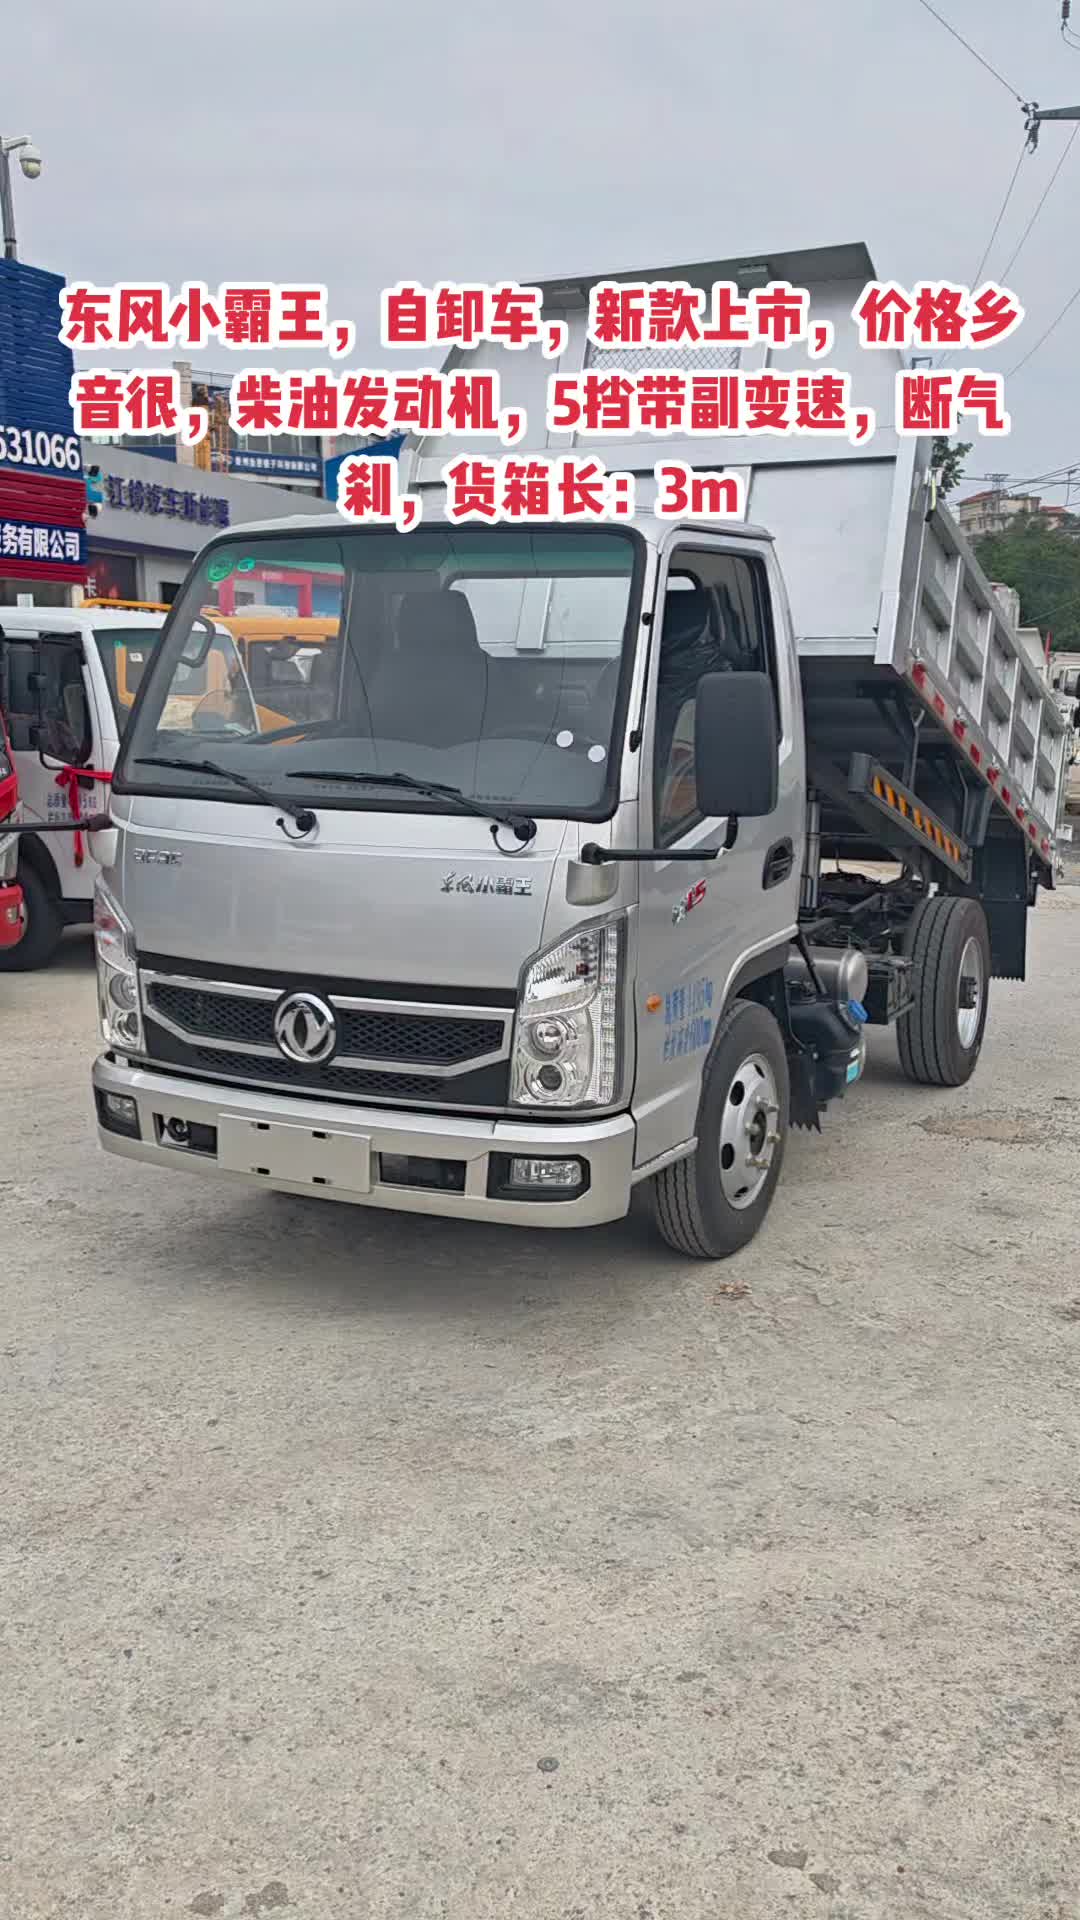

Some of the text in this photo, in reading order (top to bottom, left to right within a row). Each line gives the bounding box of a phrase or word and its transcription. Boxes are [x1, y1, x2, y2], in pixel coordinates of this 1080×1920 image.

[0, 523, 80, 561] 务有限公司
